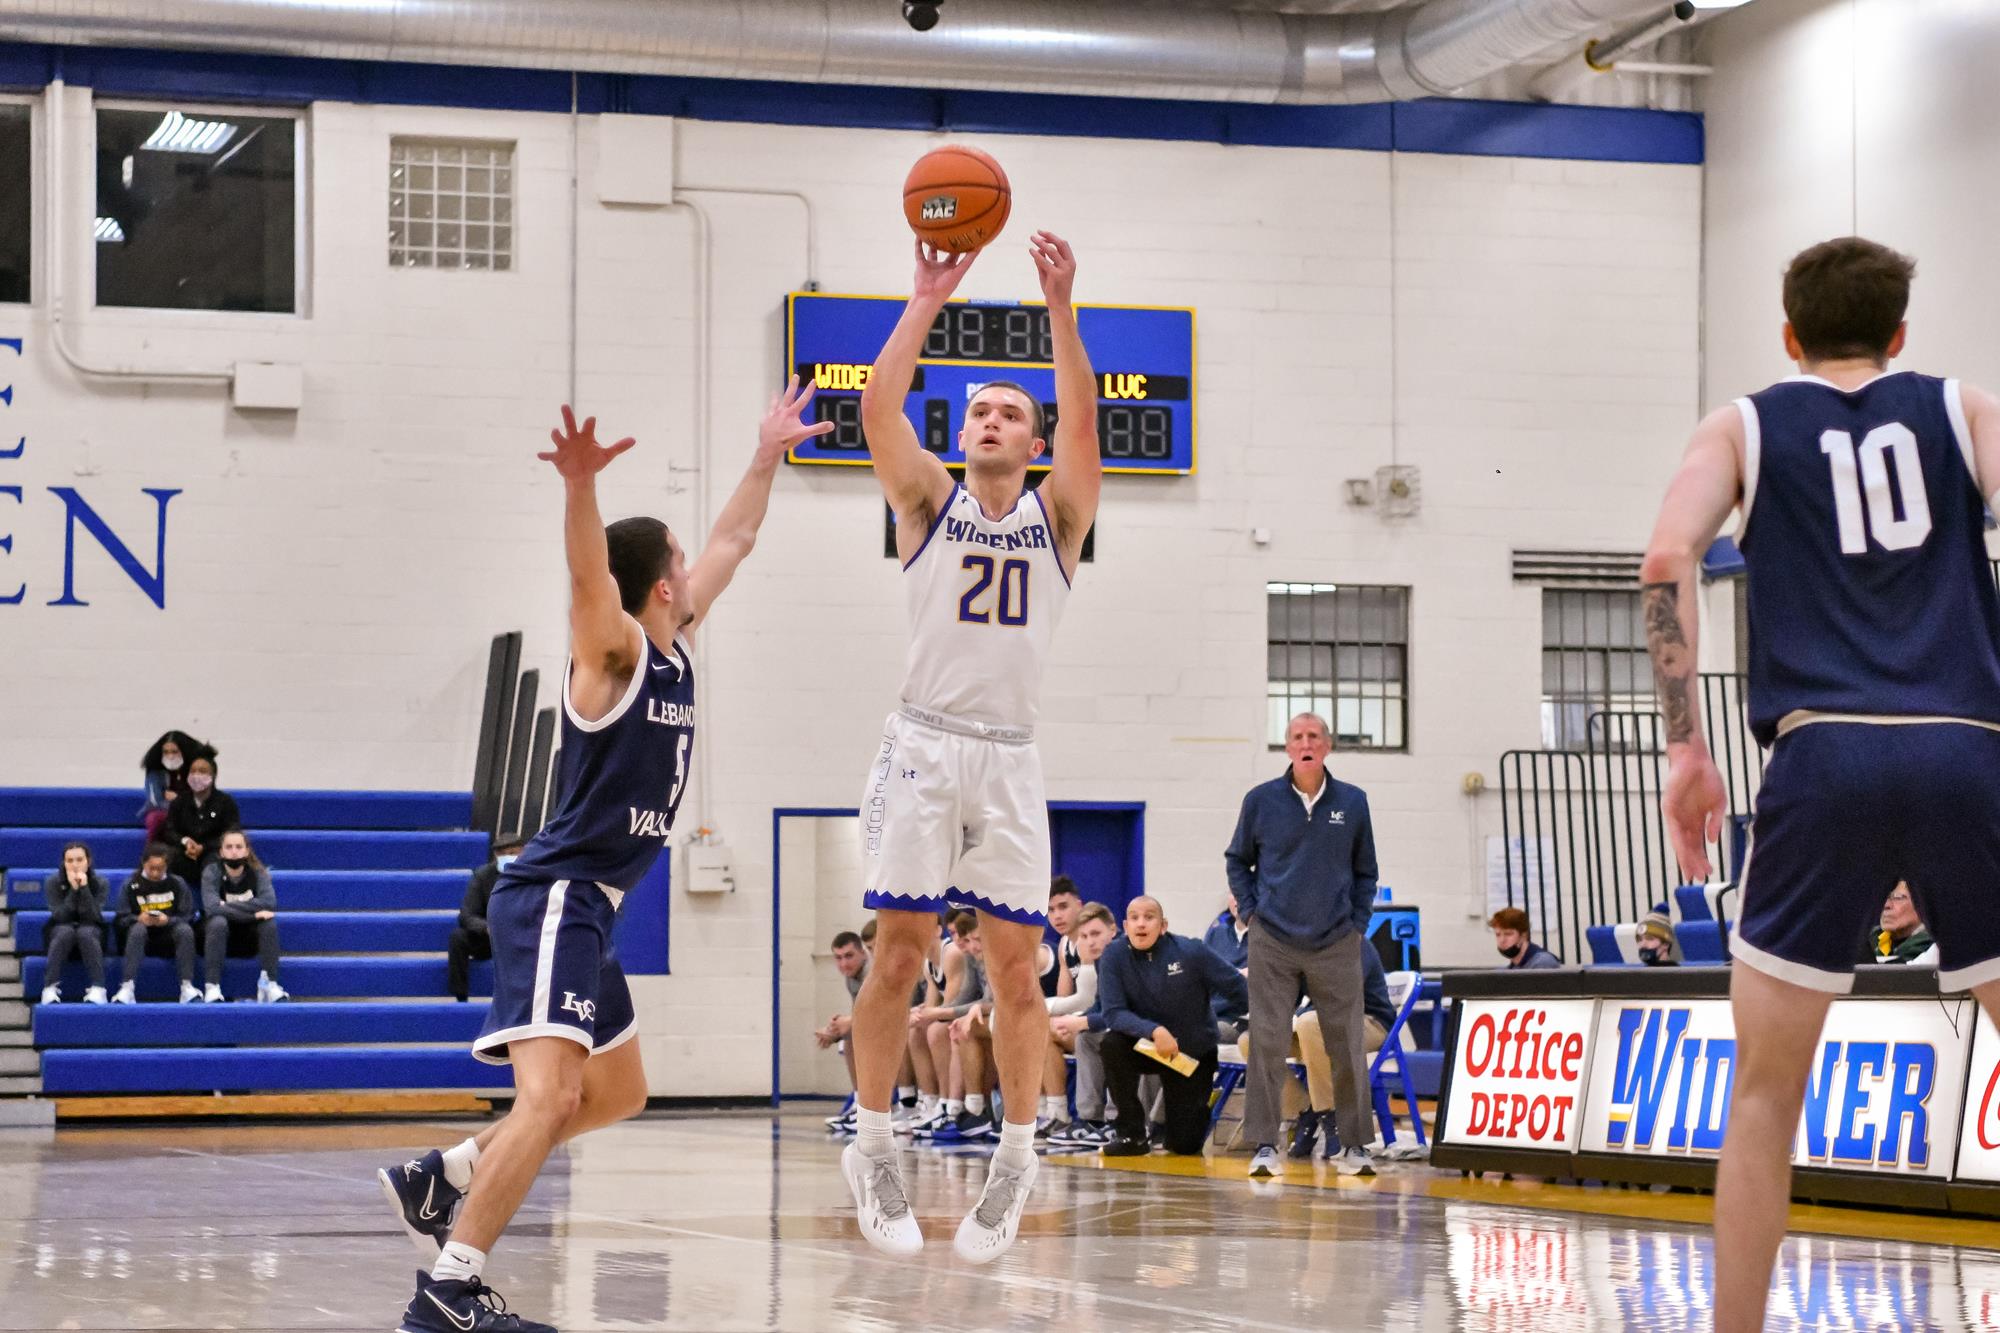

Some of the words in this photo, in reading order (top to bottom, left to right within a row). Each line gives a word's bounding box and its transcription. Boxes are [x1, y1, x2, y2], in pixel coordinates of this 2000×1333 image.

[923, 206, 955, 219] MAC
[815, 363, 874, 390] WIDE
[1104, 373, 1147, 400] LVC
[1820, 421, 1933, 554] 10
[946, 516, 1048, 551] WIDENER
[957, 553, 1031, 627] 20
[647, 698, 694, 727] LEBANO
[629, 806, 671, 836] VALL
[1465, 1008, 1584, 1082] Office
[1606, 1007, 1937, 1168] WIDNER
[1466, 1092, 1573, 1142] DEPOT
